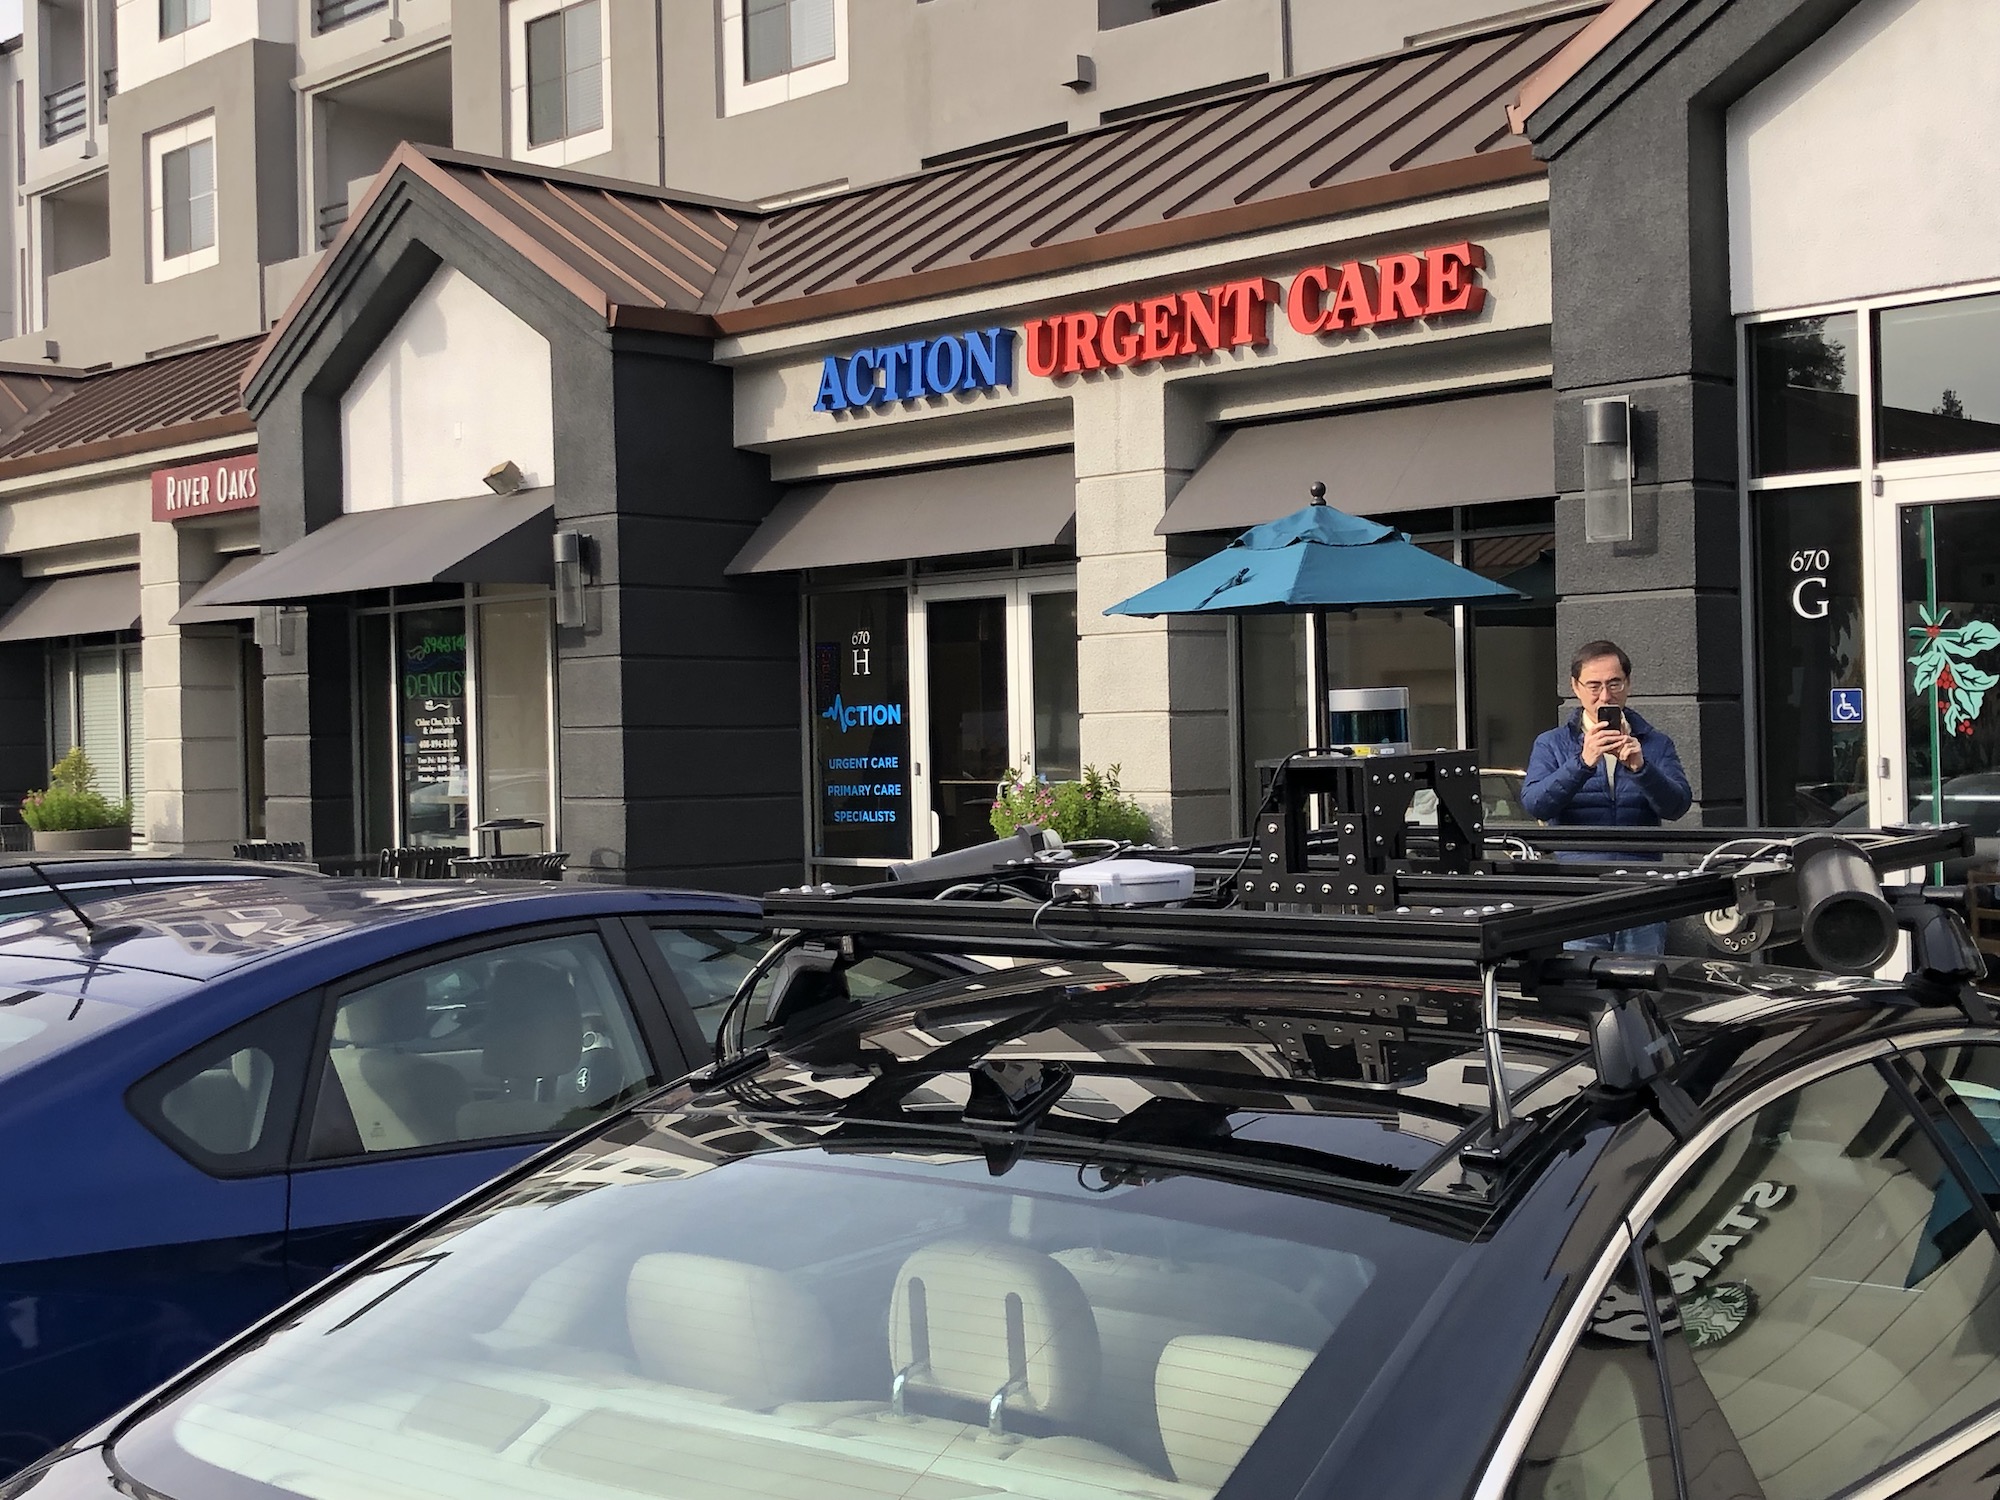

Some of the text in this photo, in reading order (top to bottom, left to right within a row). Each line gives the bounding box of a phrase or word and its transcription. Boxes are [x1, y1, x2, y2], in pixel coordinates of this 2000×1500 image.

[813, 241, 1485, 413] ACTION URGENT CARE
[166, 467, 257, 511] RIVER OAKS
[1790, 549, 1830, 572] 670
[1792, 576, 1830, 619] G
[851, 630, 871, 646] 670
[852, 648, 871, 676] H
[405, 670, 467, 699] DENTIS
[828, 756, 899, 770] URGENT CARE
[827, 783, 902, 797] PRIMARY CARE
[834, 810, 896, 823] SPECIALISTS
